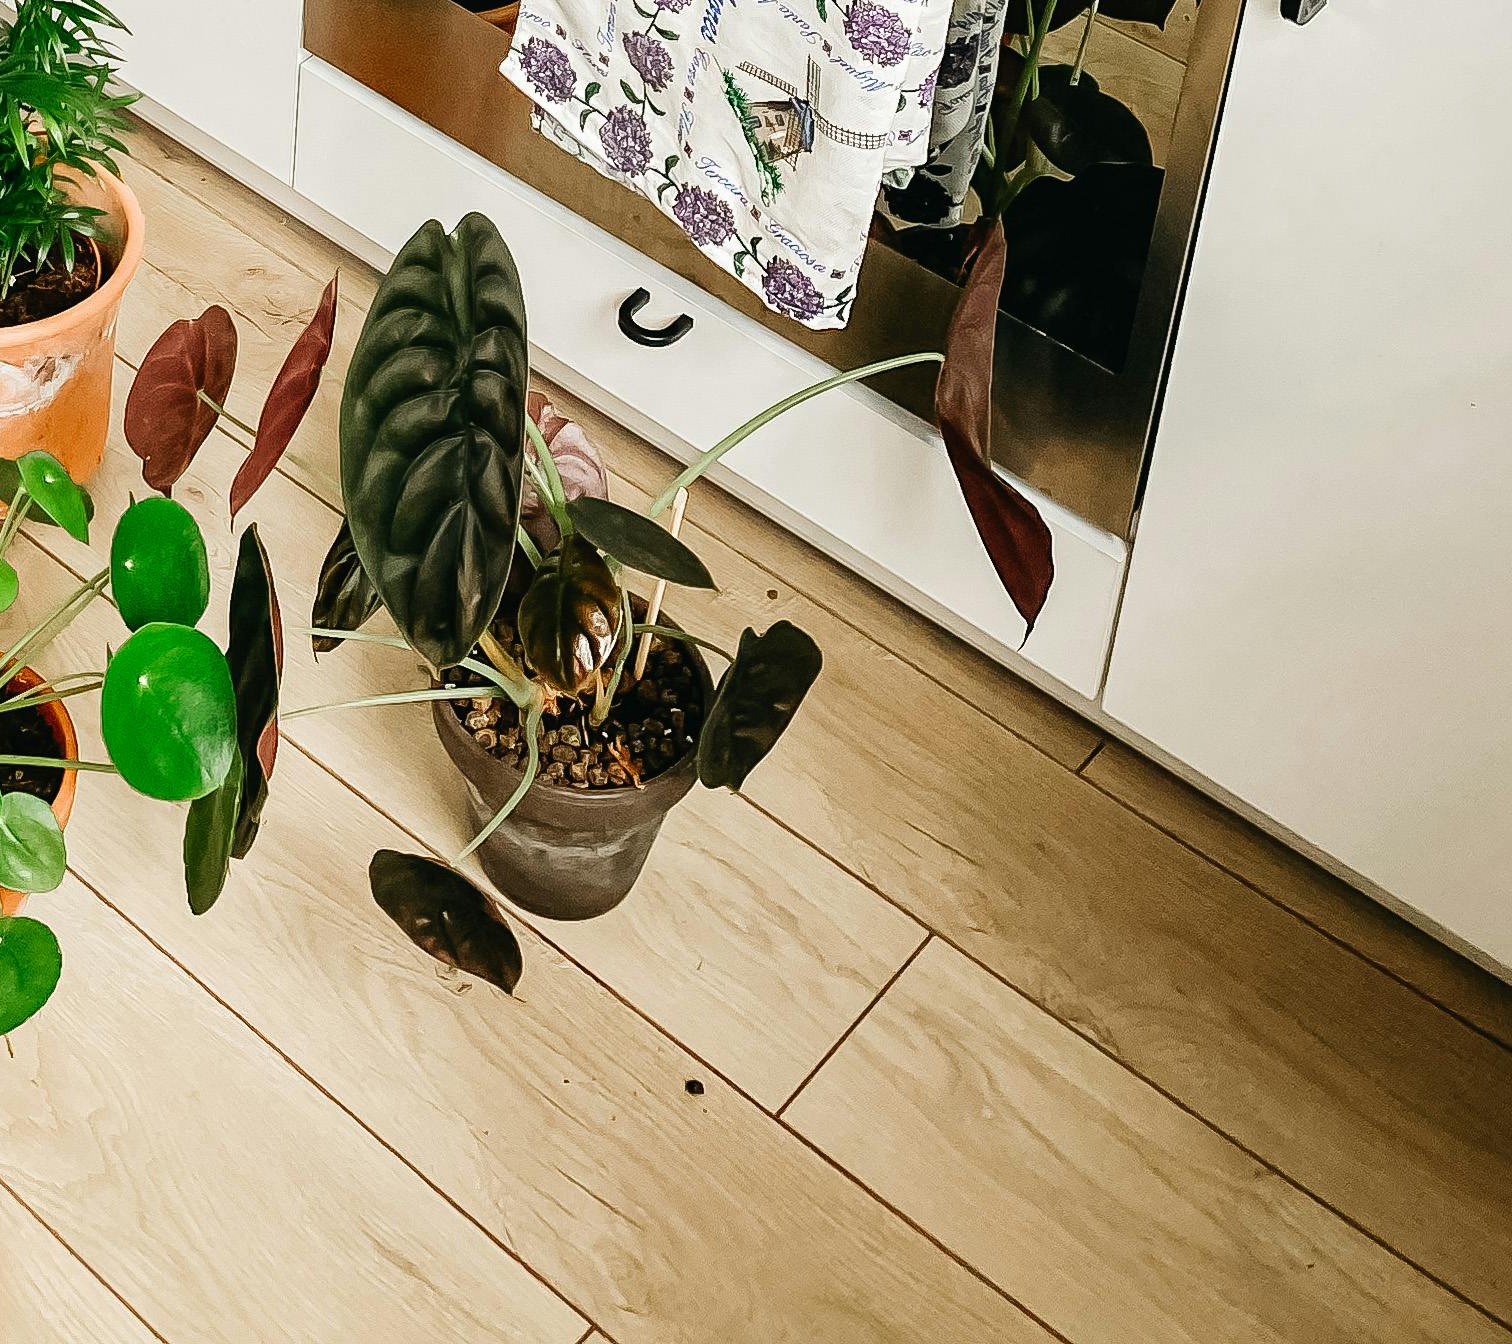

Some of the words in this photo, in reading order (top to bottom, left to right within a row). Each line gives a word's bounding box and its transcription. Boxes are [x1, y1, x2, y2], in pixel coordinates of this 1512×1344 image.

[519, 5, 551, 29] orvo
[695, 156, 749, 207] Terceira
[764, 215, 828, 274] Graciosa
